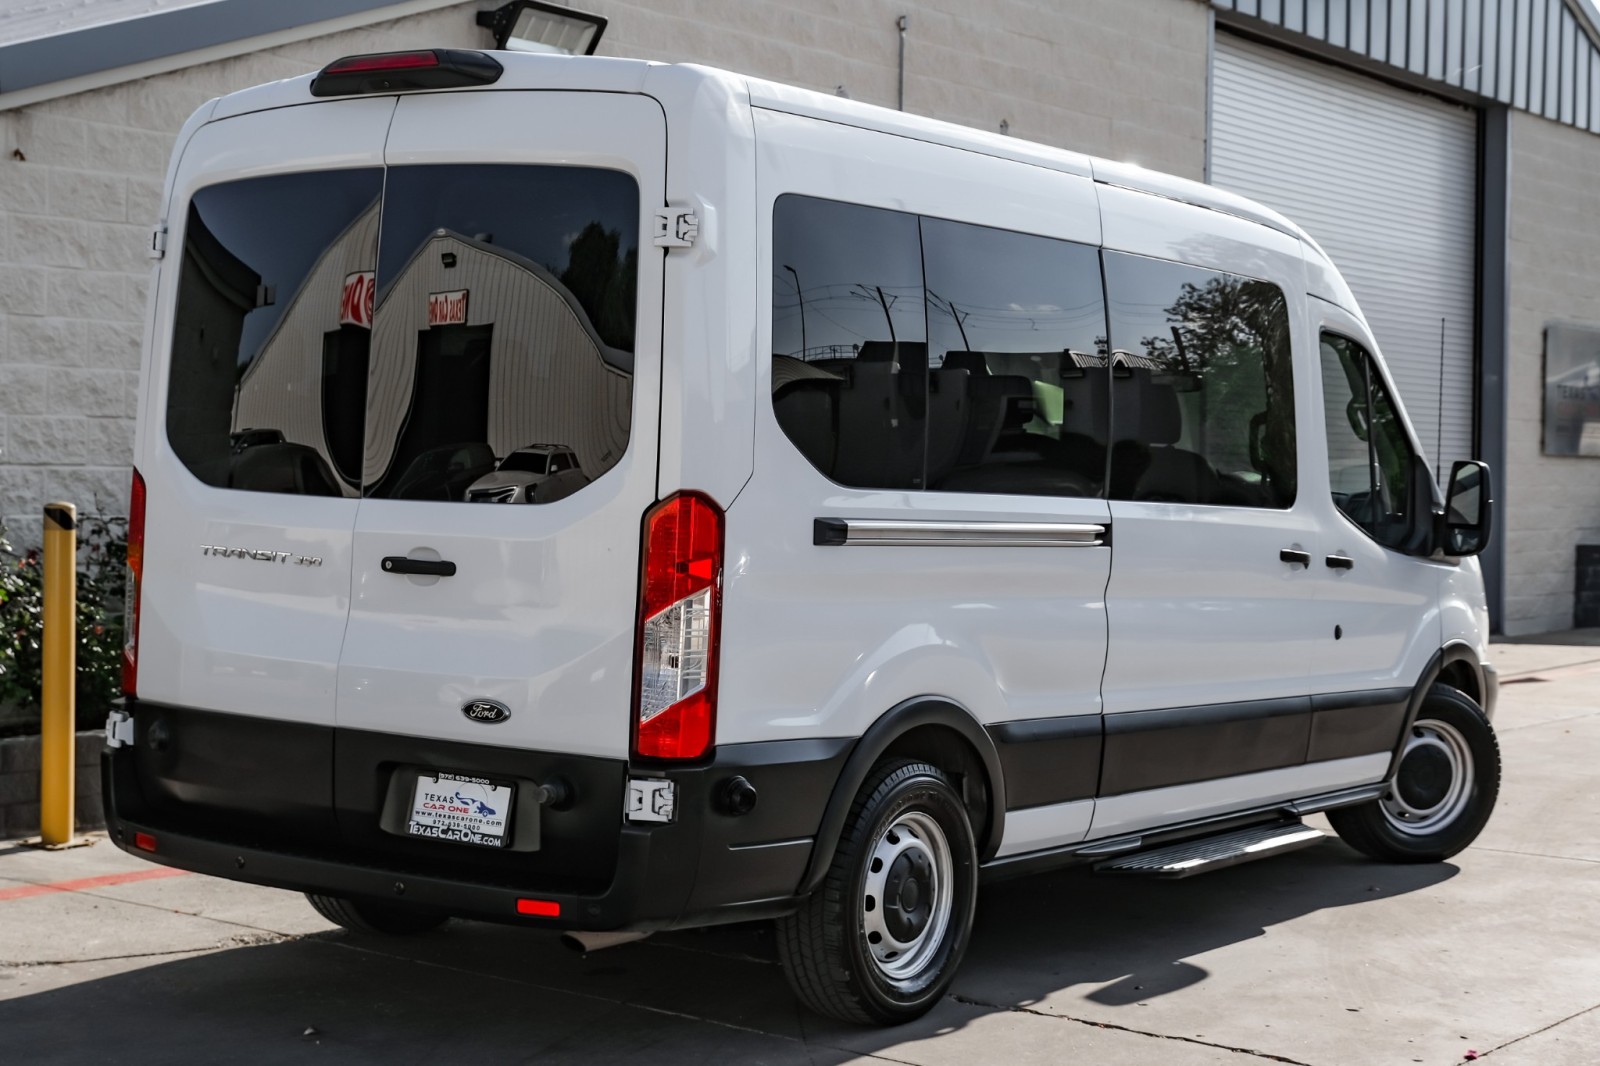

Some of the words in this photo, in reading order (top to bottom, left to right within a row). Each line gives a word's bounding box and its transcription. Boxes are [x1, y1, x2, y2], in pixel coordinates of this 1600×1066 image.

[200, 544, 292, 564] TRANSIT
[294, 555, 323, 567] 350
[470, 703, 498, 719] Ford
[439, 772, 454, 781] (972)
[455, 775, 490, 785] 639-5000
[424, 793, 455, 804] TEXAS
[423, 802, 445, 810] CAR
[447, 806, 470, 814] ONE
[415, 809, 502, 826] www.texascarone.com
